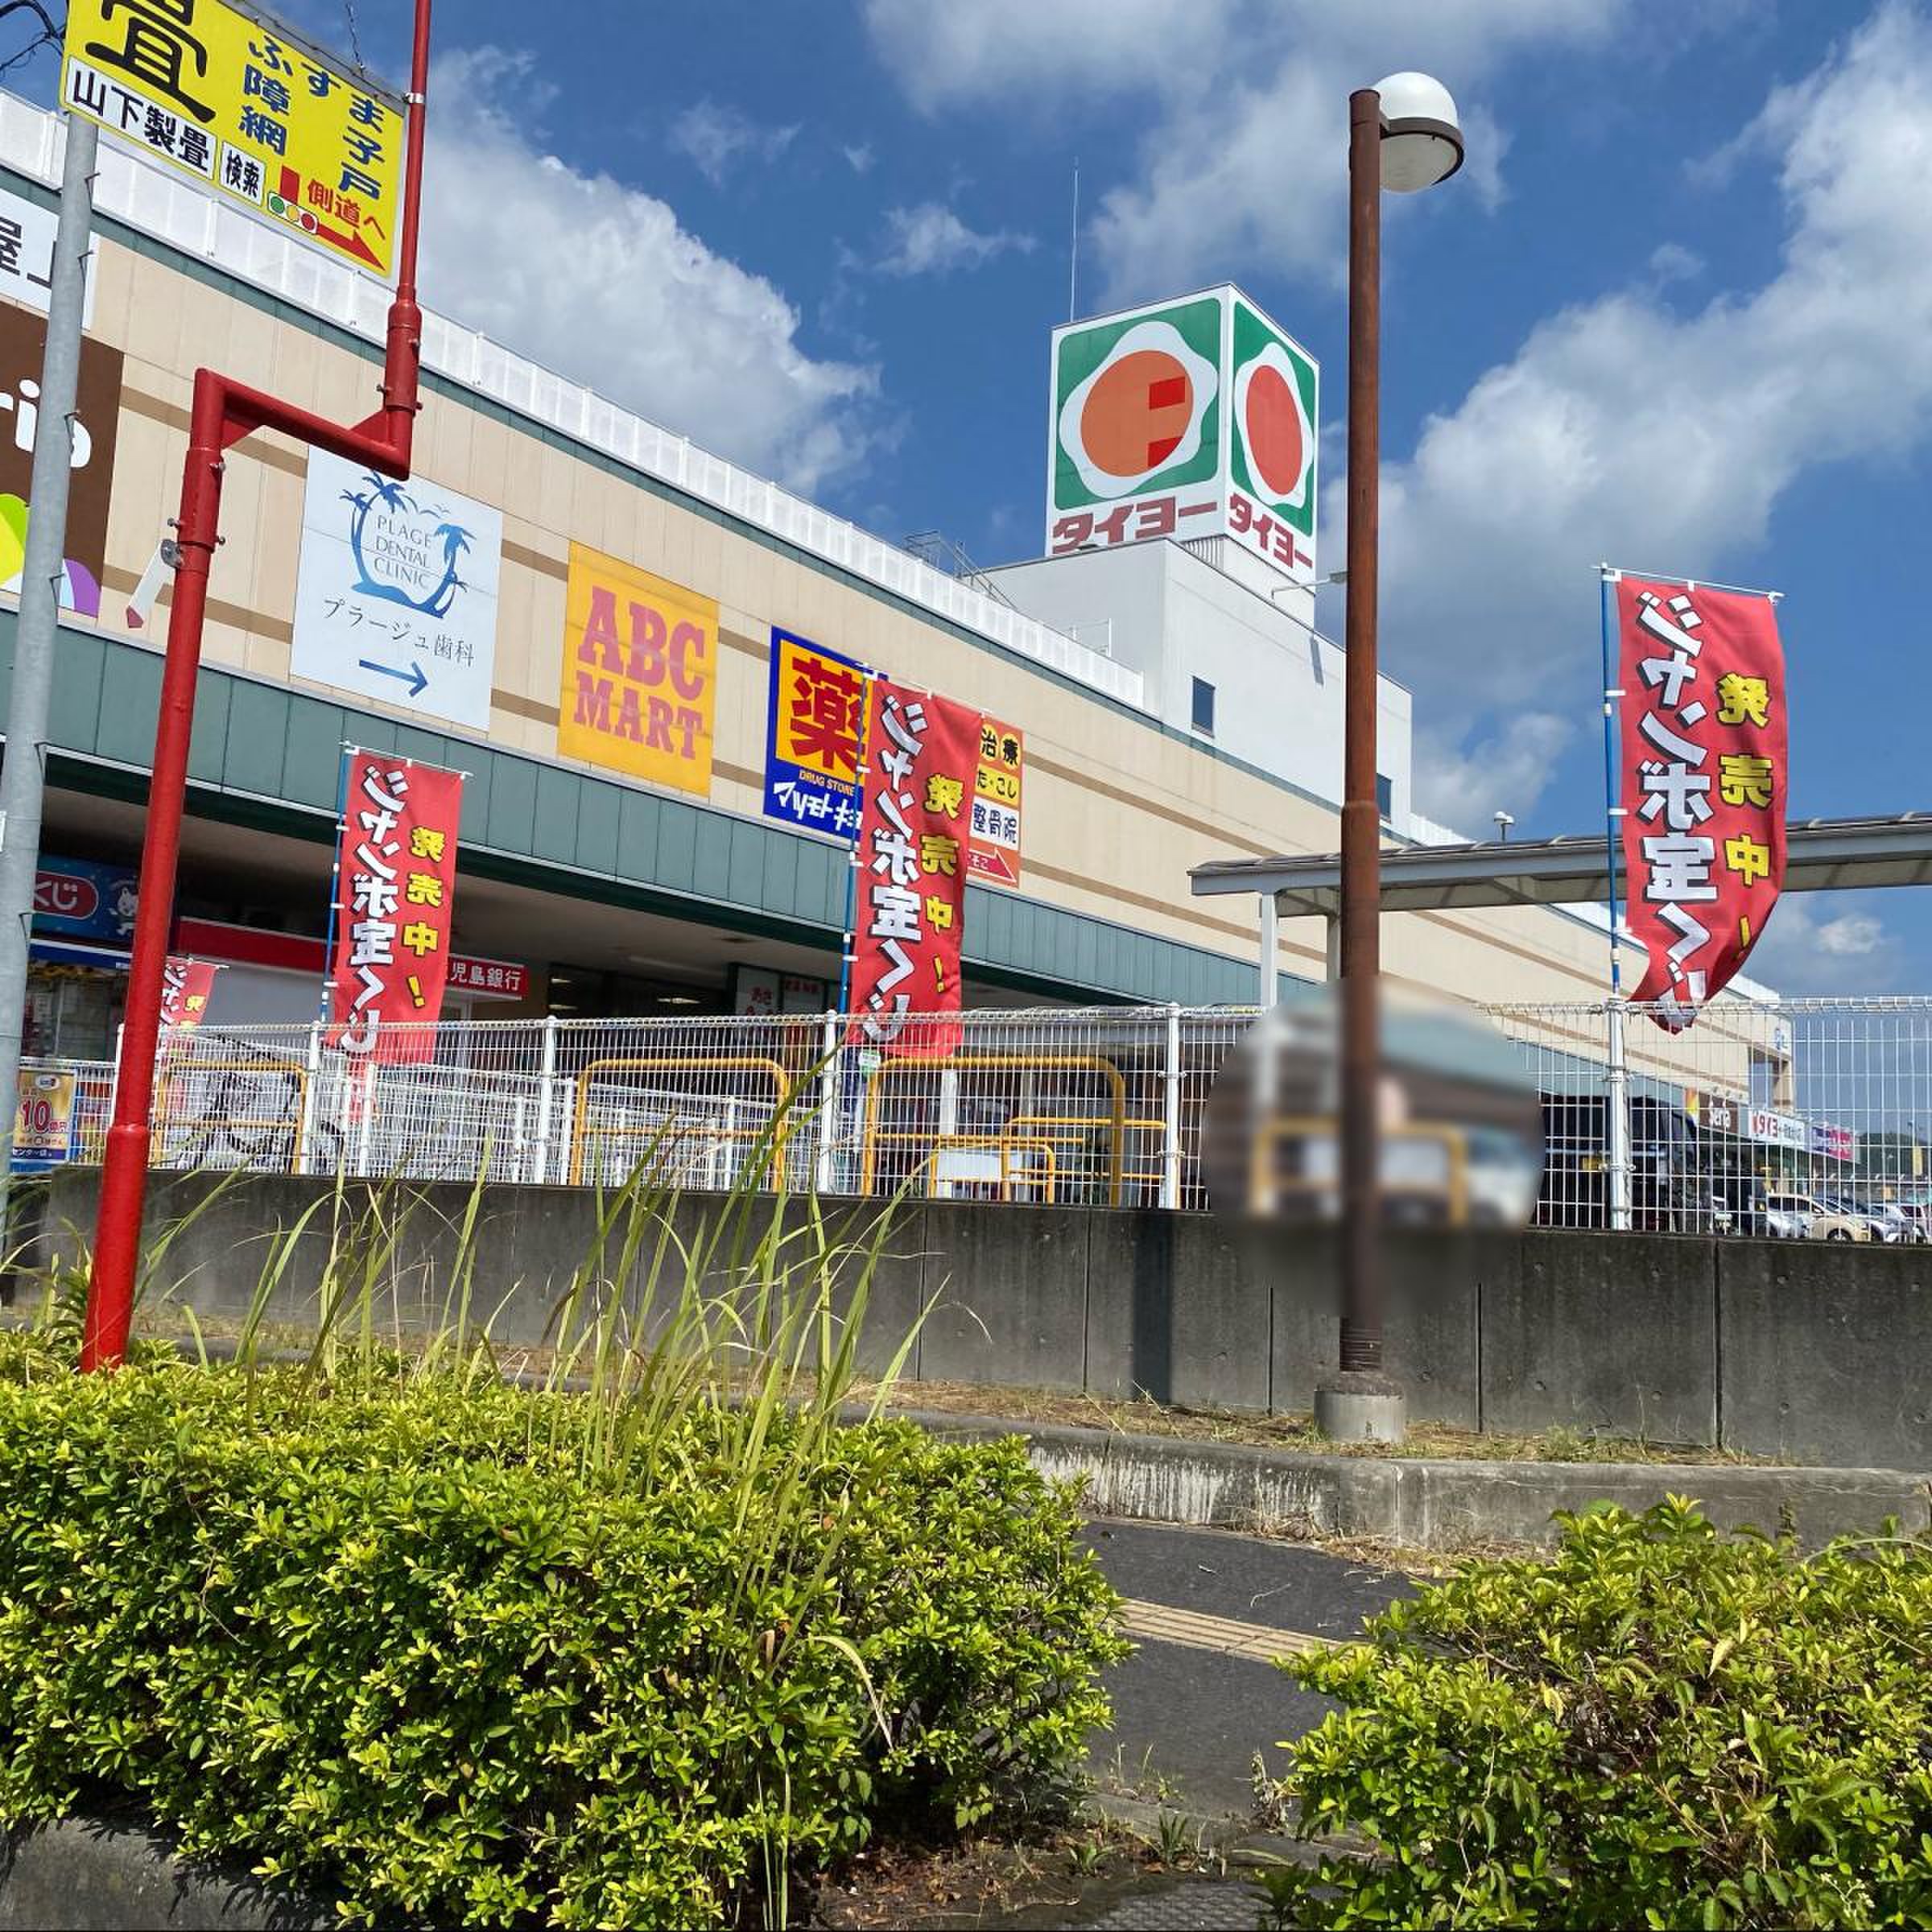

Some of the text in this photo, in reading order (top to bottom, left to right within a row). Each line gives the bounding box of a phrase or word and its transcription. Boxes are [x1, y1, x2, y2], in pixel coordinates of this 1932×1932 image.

[243, 64, 385, 164] 障子
[248, 35, 384, 133] ふすま
[73, 70, 208, 171] 山下製畳
[239, 105, 382, 200] 網戸
[225, 150, 260, 198] 検索
[308, 179, 386, 240] 側道へ
[376, 535, 428, 568] DENTAL
[377, 515, 431, 548] PLAGE
[1052, 497, 1217, 554] タイヨー
[1228, 492, 1313, 568] タイヨー
[374, 556, 431, 590] CLINIC
[324, 598, 474, 667] プラージュ歯科
[577, 585, 705, 703] ABC
[574, 669, 703, 761] MART
[790, 657, 866, 774] 薬
[980, 729, 1018, 766] 治療
[799, 770, 825, 786] DRUG
[973, 803, 1018, 844] 整骨院
[862, 692, 928, 1042] ジャンボ宝くじ
[340, 764, 411, 1054] ジャンボ宝くじ
[449, 961, 522, 991] 児島銀行
